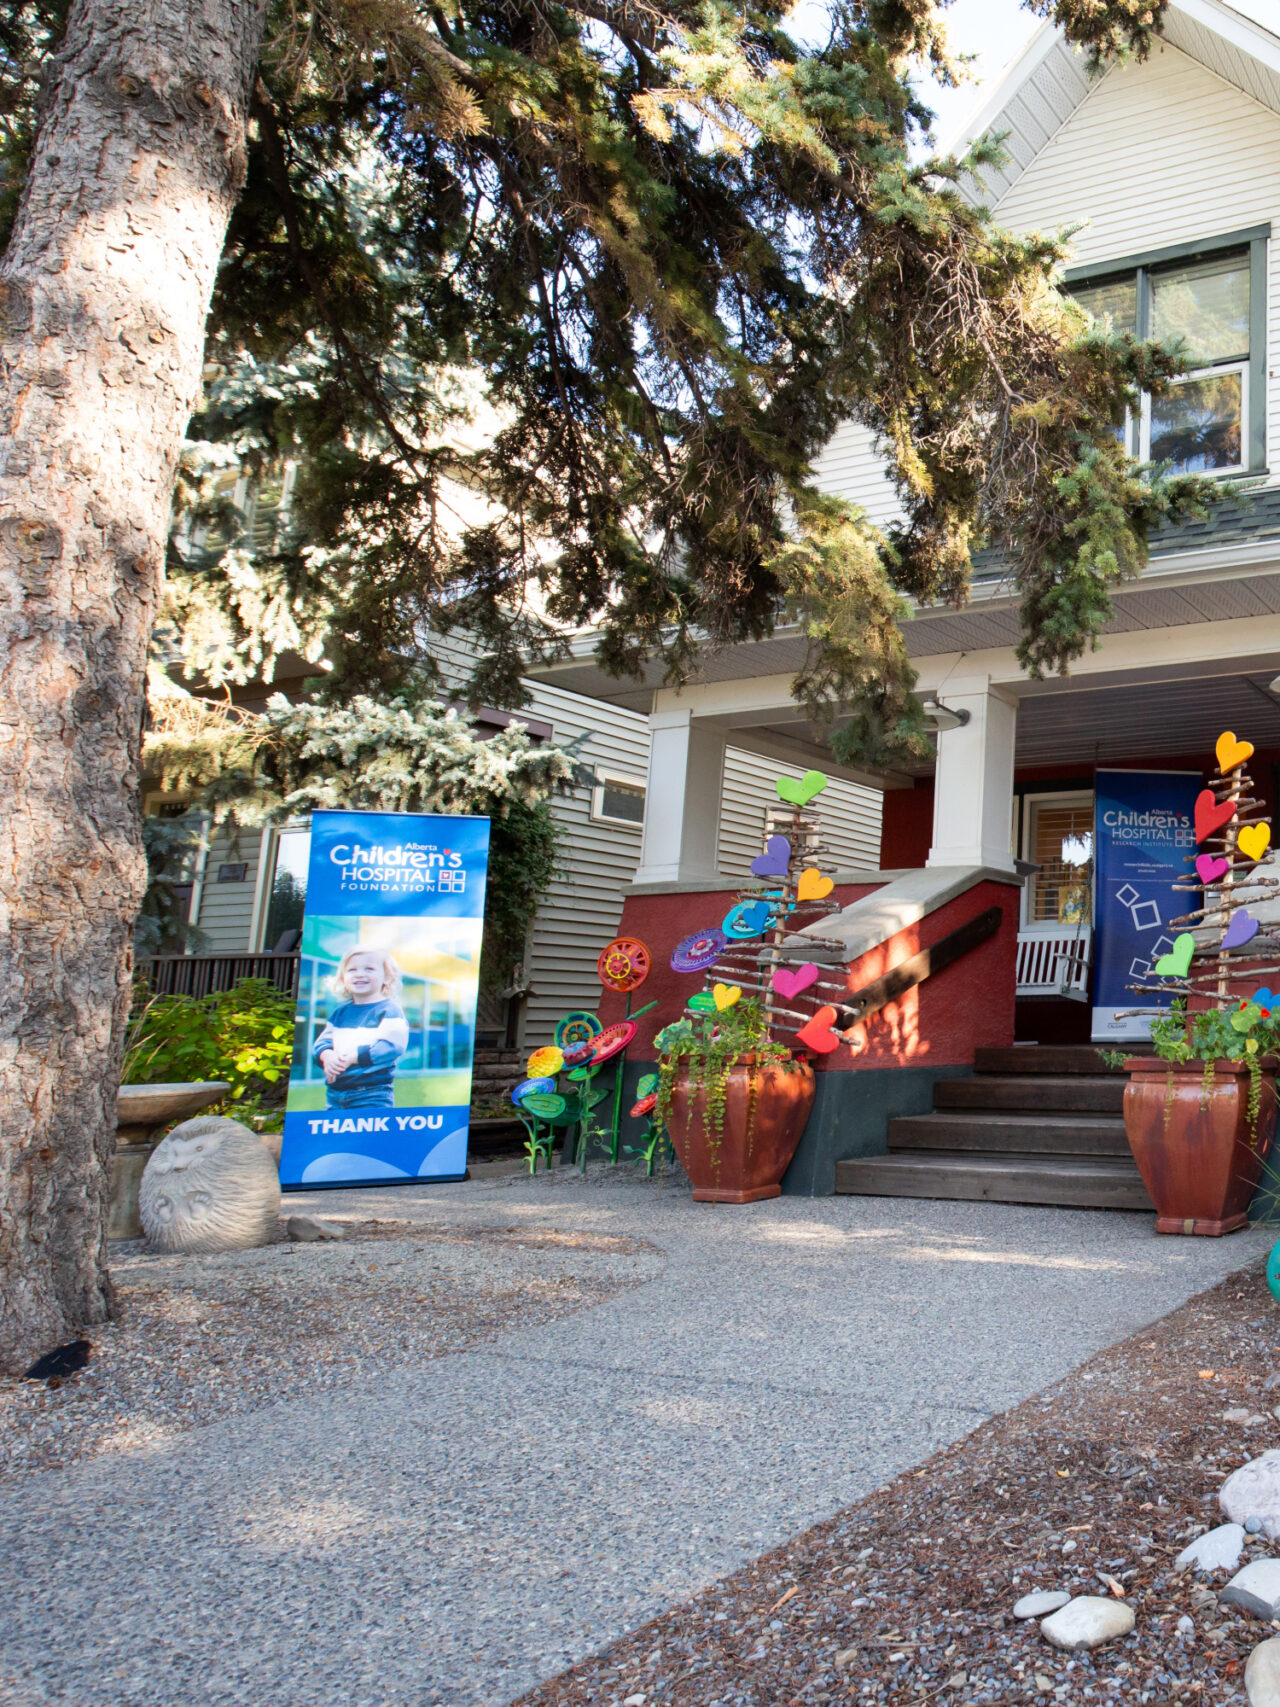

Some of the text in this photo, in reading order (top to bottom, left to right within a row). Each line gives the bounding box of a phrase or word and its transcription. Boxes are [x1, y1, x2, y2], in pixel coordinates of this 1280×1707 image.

[1103, 811, 1190, 828] Children's
[1112, 828, 1173, 840] HOSPITAL
[405, 842, 437, 851] Alberta
[330, 844, 462, 868] Children's
[342, 867, 435, 883] HOSPITAL
[341, 883, 435, 892] FOUNDATION
[308, 1115, 443, 1135] THANK YOU
